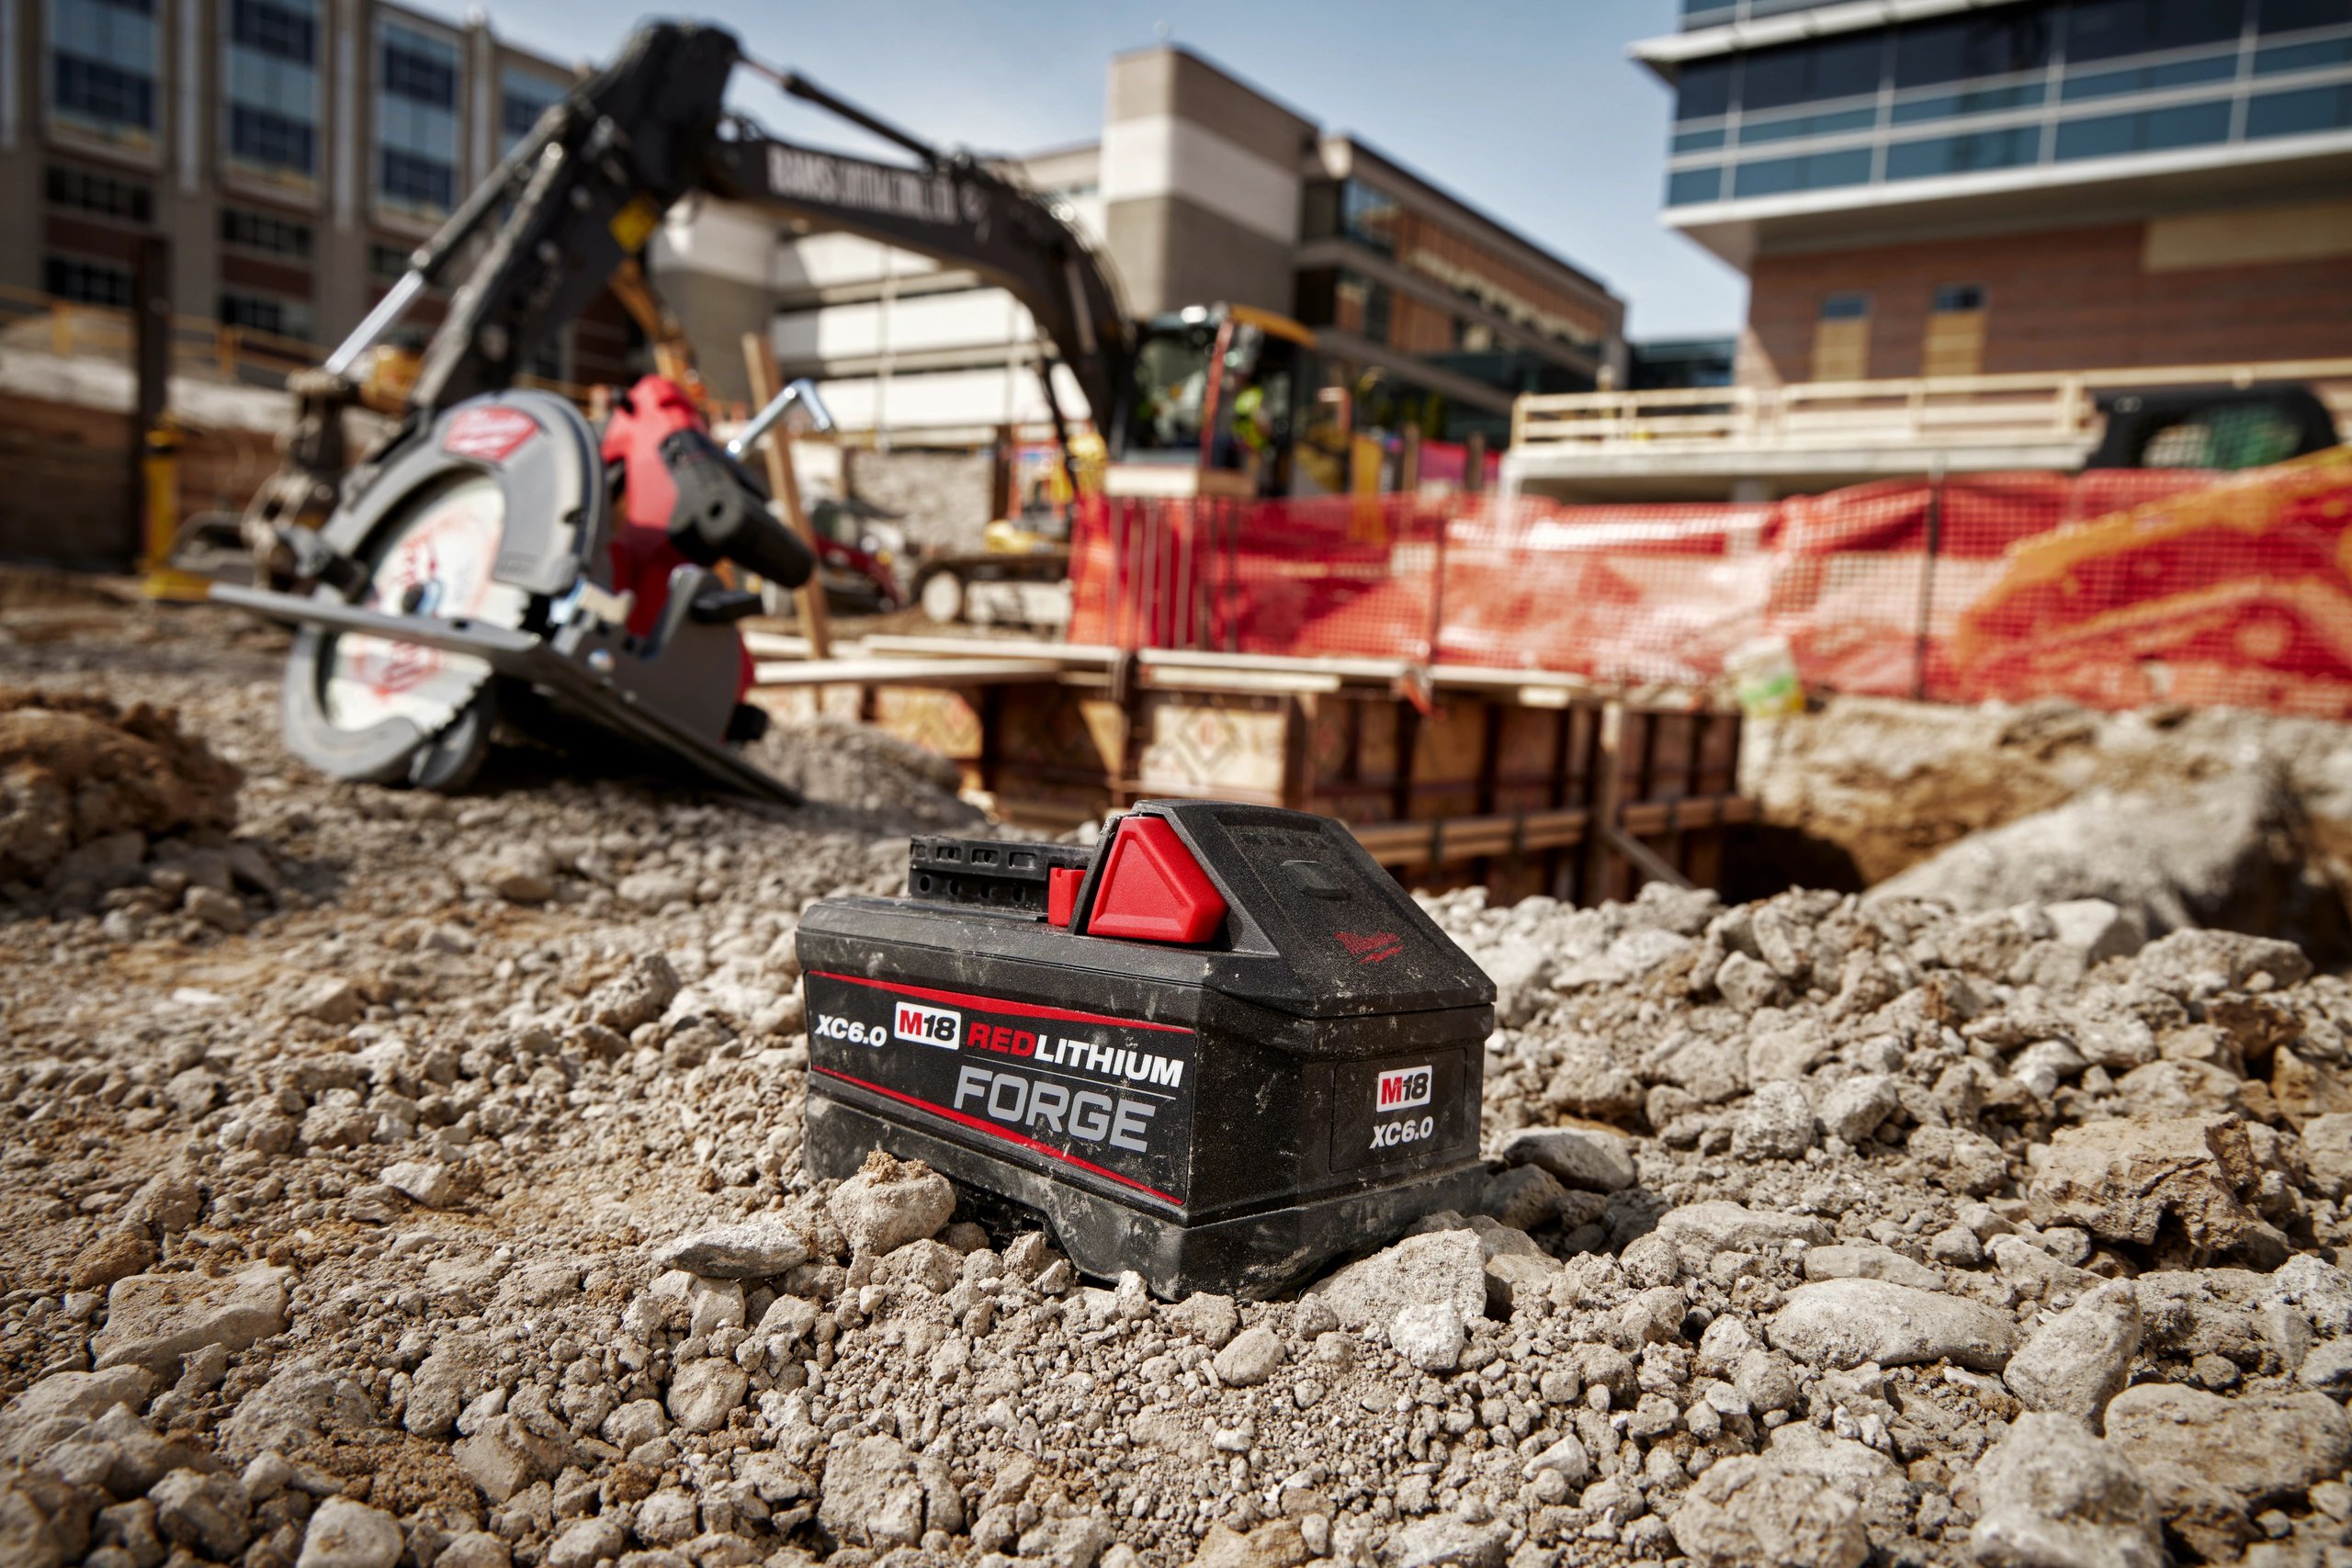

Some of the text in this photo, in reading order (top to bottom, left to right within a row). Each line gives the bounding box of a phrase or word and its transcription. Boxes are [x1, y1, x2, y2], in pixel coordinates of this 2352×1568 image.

[814, 1014, 888, 1047] XC6.0
[899, 1010, 957, 1042] M18
[1381, 1073, 1430, 1105] M18
[953, 1065, 1156, 1153] FORGE
[1369, 1116, 1434, 1150] XC6.0
